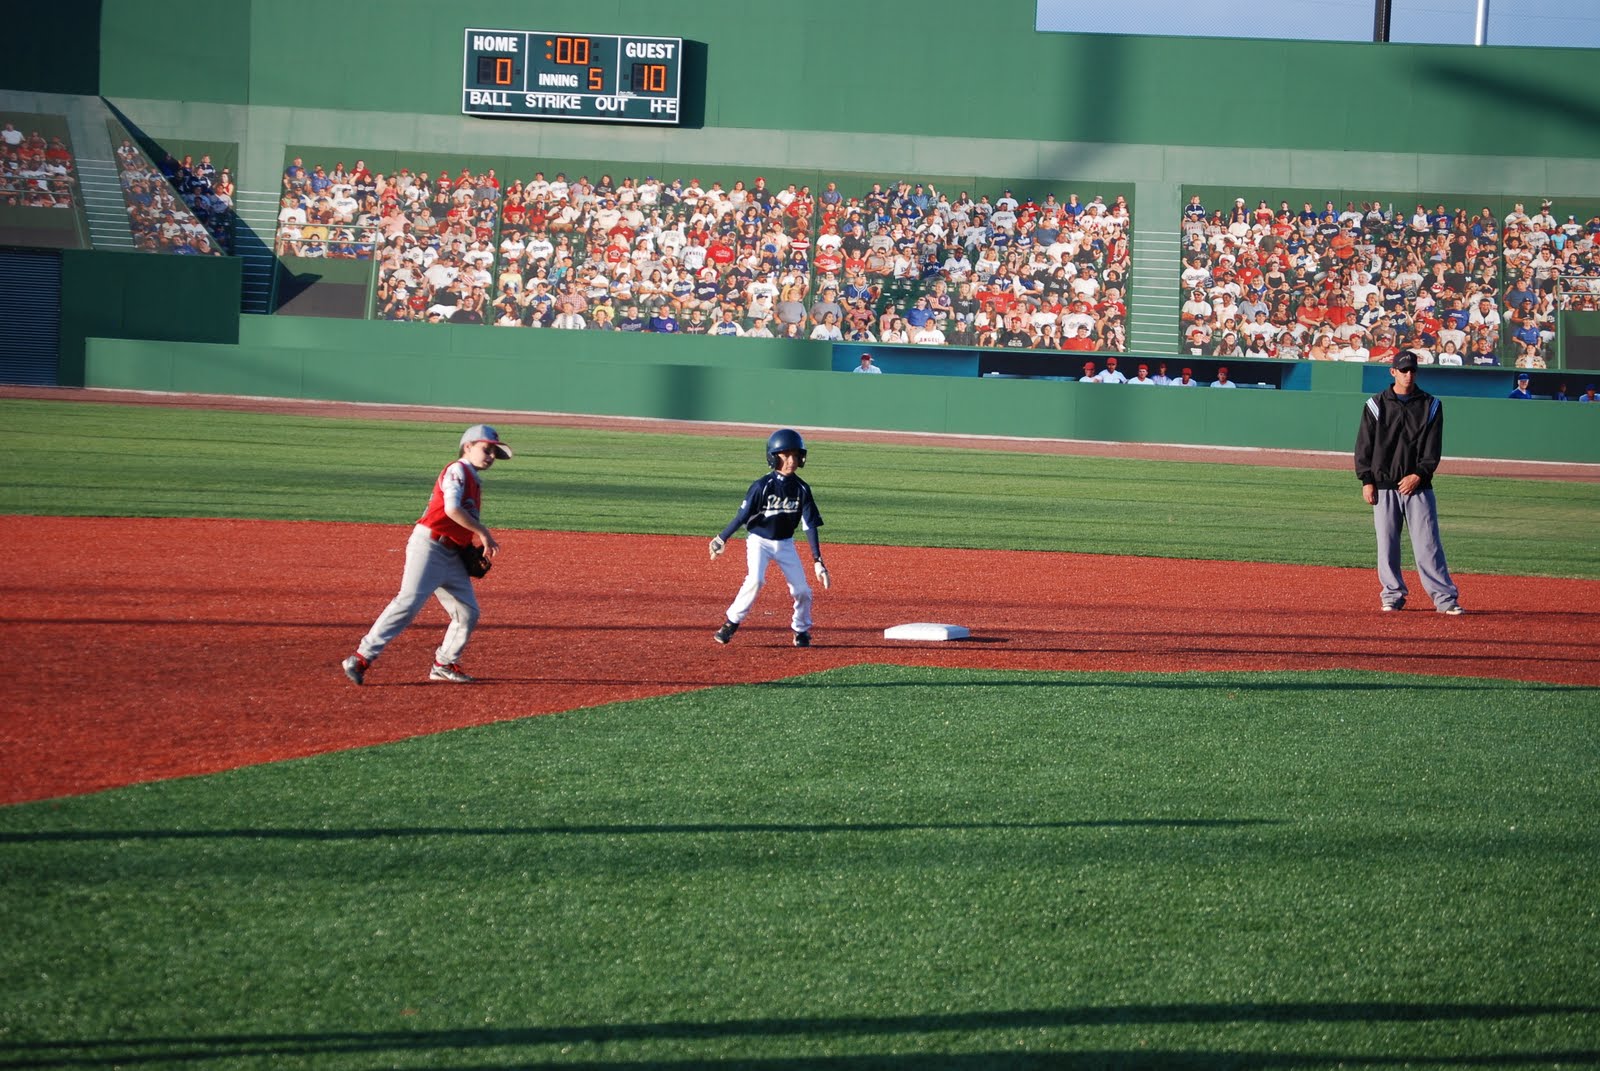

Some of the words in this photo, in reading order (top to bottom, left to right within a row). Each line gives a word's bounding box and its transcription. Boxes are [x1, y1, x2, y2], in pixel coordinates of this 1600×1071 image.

[473, 35, 518, 53] HOME
[625, 42, 675, 60] GUEST
[495, 58, 512, 85] 0
[538, 73, 579, 88] INNING
[588, 67, 602, 90] 5
[642, 65, 667, 92] 10
[469, 91, 512, 107] BALL
[525, 95, 581, 110] STRIKE
[595, 97, 629, 112] OUT
